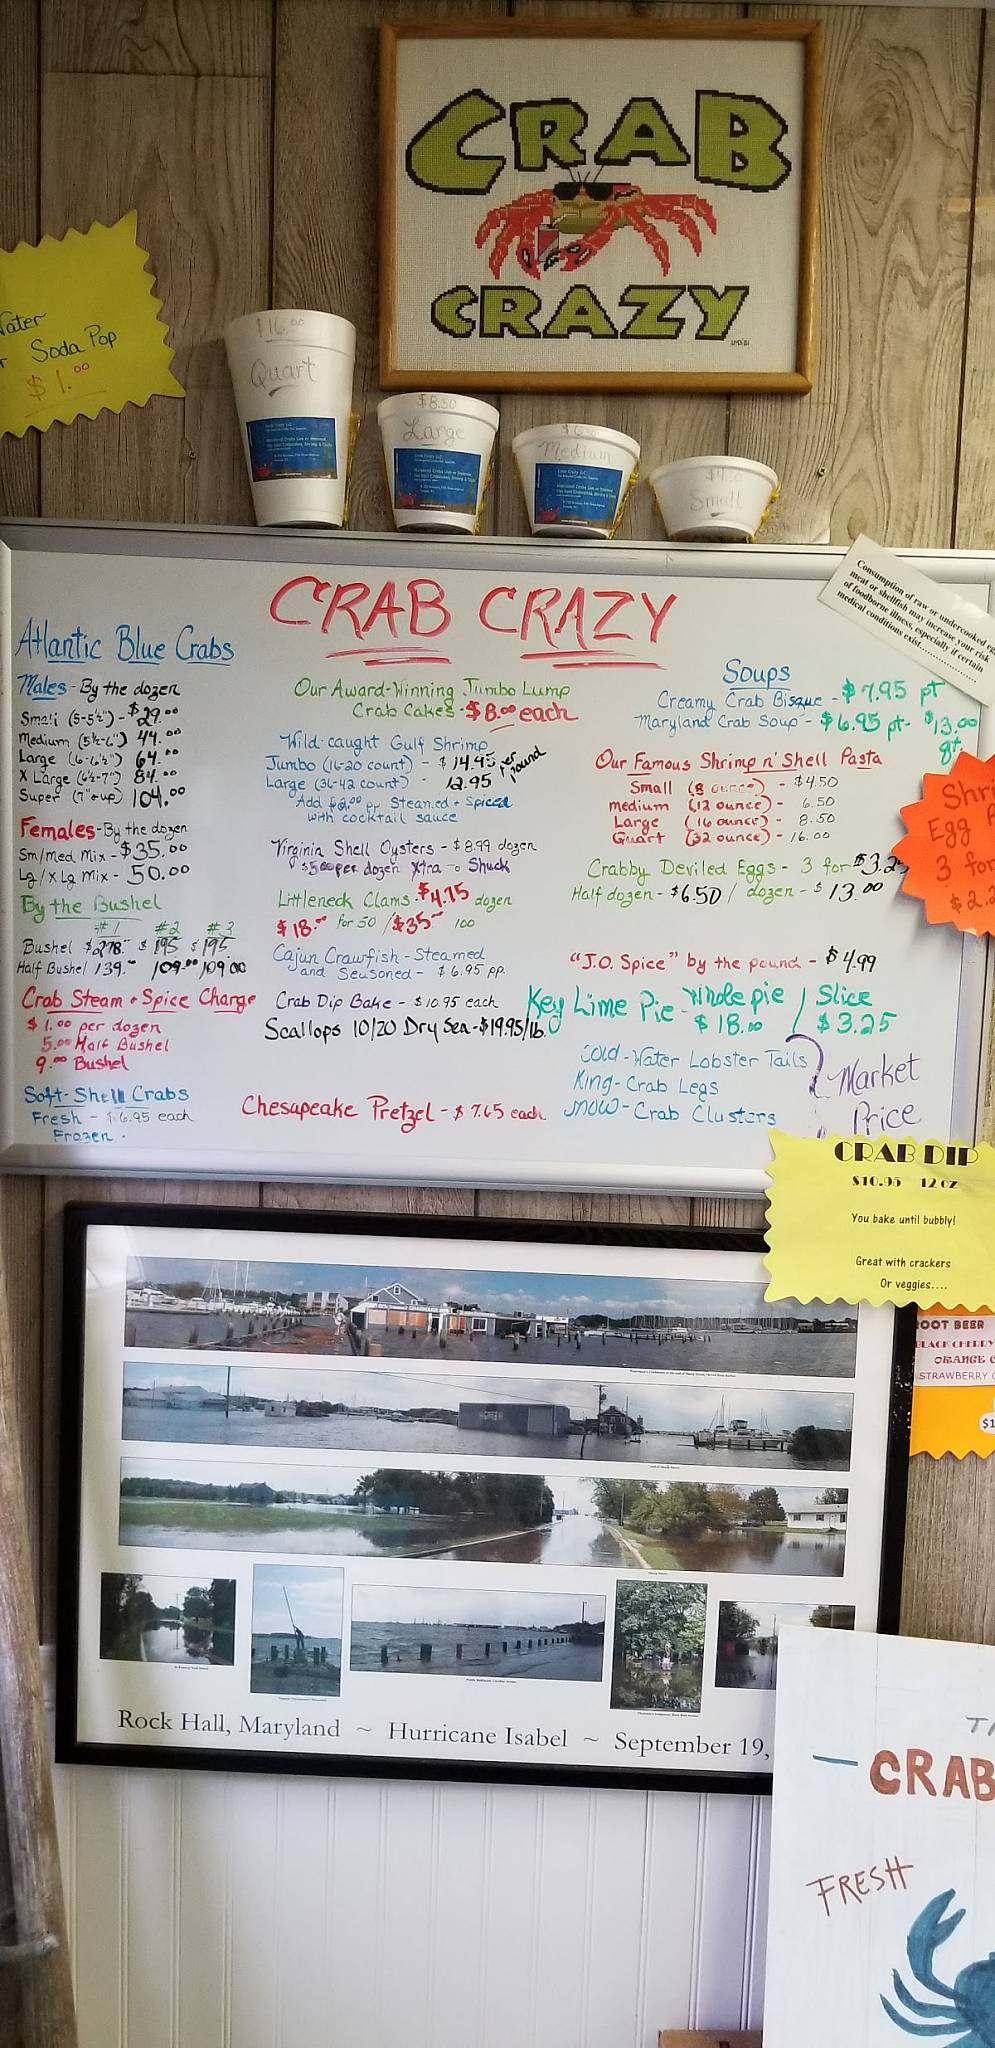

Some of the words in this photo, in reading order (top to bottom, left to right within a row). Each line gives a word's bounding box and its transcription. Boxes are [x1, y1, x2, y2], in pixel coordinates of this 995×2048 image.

[405, 88, 792, 194] CRAB
[431, 284, 750, 340] CRAZY
[30, 338, 86, 363] Soda
[84, 324, 117, 348] Pop
[251, 355, 317, 389] Quart
[402, 417, 465, 446] Large
[690, 488, 743, 512] Small
[269, 576, 453, 640] CRAB
[479, 586, 679, 649] CRAZY
[837, 590, 866, 613] medical
[866, 608, 903, 637] conditions
[857, 559, 905, 596] Consumption
[914, 597, 928, 611] raw
[939, 613, 987, 648] undercooked
[850, 569, 868, 585] meat
[879, 588, 908, 610] shellfish
[908, 607, 925, 623] may
[926, 618, 956, 642] increase
[955, 638, 974, 653] your
[974, 648, 990, 663] risk
[852, 583, 890, 613] foodborne
[889, 609, 914, 632] illness,
[914, 625, 950, 652] especially
[957, 652, 984, 673] certain
[15, 618, 102, 660] Atlantic
[116, 624, 165, 661] Blue
[176, 625, 235, 660] Crabs
[723, 658, 791, 690] Soups
[103, 681, 127, 695] the
[134, 681, 180, 700] dozen
[294, 678, 327, 697] Our
[523, 681, 570, 697] Lump
[353, 702, 397, 718] Crab
[519, 701, 579, 722] each
[657, 690, 716, 715] Creamy
[725, 691, 764, 708] Crab
[634, 714, 710, 737] Maryland
[718, 715, 750, 728] Crab
[19, 734, 70, 747] Medium
[391, 736, 424, 754] Gulf
[433, 737, 488, 753] Shrimp
[266, 755, 316, 772] Jumbo
[596, 749, 627, 769] Our
[634, 752, 691, 770] Famous
[701, 752, 757, 772] Shrimp
[782, 752, 826, 767] Shell
[841, 747, 882, 765] Pasta
[630, 780, 672, 794] Small
[296, 796, 322, 809] Add
[803, 797, 835, 809] 6.50
[307, 812, 335, 824] with
[343, 811, 405, 825] cocktail
[416, 812, 458, 823] sauce
[615, 816, 659, 836] Large
[799, 813, 836, 827] 8.50
[125, 821, 147, 834] the
[152, 823, 187, 840] dozen
[928, 818, 971, 848] Egg
[81, 849, 105, 862] Mix
[334, 840, 370, 857] Shell
[499, 838, 537, 855] dozen
[82, 869, 108, 882] Mix
[587, 858, 651, 887] Crabby
[659, 858, 728, 877] Deviled
[801, 857, 813, 873] 3
[936, 855, 951, 882] 3
[49, 899, 82, 914] the
[94, 894, 162, 912] Bushel
[278, 890, 354, 909] Littleneck
[364, 892, 411, 909] Clams
[475, 895, 513, 913] dozen
[571, 886, 603, 906] Half
[746, 884, 794, 906] dozen
[357, 916, 377, 929] 50
[455, 919, 476, 929] 100
[22, 939, 73, 956] Bushel
[272, 944, 319, 972] Cajun
[17, 961, 42, 979] Half
[47, 961, 87, 974] Bushel
[300, 965, 326, 978] and
[687, 952, 706, 974] by
[714, 955, 740, 969] the
[22, 986, 62, 1009] Crab
[71, 989, 123, 1008] Steam
[142, 989, 189, 1011] Spice
[200, 987, 257, 1014] Charge
[276, 991, 311, 1010] Crab
[317, 992, 343, 1013] Dip
[465, 996, 499, 1009] each
[574, 986, 627, 1017] Lime
[752, 981, 784, 1014] pie
[816, 982, 873, 1007] Slice
[78, 1022, 104, 1037] per
[112, 1019, 161, 1037] dozen
[265, 1017, 341, 1044] Scallops
[353, 1017, 397, 1042] 10/20
[403, 1016, 439, 1045] Dry
[117, 1037, 168, 1051] Bushel
[75, 1055, 128, 1070] Bushel
[689, 1050, 759, 1068] Lobster
[765, 1050, 807, 1068] Tails
[828, 1053, 920, 1097] Market
[132, 1086, 189, 1100] Crabs
[627, 1078, 668, 1093] Crab
[679, 1078, 719, 1102] Legs
[33, 1112, 82, 1125] Fresh
[158, 1109, 194, 1122] each
[241, 1095, 358, 1121] Chesapeake
[367, 1095, 435, 1134] Pretzel
[634, 1104, 679, 1121] Crab
[853, 1102, 919, 1136] Price
[54, 1130, 113, 1143] Frozen
[835, 1141, 916, 1162] CRAB
[924, 1145, 979, 1166] DIP
[852, 1176, 901, 1187] $10.95
[851, 1213, 869, 1223] You
[873, 1214, 895, 1224] bake
[899, 1215, 920, 1225] until
[923, 1215, 956, 1228] bubbly!
[856, 1256, 882, 1266] Great
[885, 1257, 906, 1267] with
[909, 1258, 951, 1268] crackers
[880, 1279, 892, 1288] Or
[954, 1320, 985, 1330] BEER
[952, 1340, 994, 1348] CHERRY
[934, 1356, 986, 1364] ORANGE
[919, 1372, 988, 1380] STRAWBERRY
[118, 1710, 172, 1731] Rock
[181, 1713, 231, 1736] Hall,
[239, 1715, 340, 1741] Maryland
[388, 1720, 497, 1745] Hurricane
[504, 1726, 568, 1747] Isabel
[614, 1731, 732, 1757] September
[739, 1737, 771, 1761] 19,
[806, 1856, 914, 1917] FRESH
